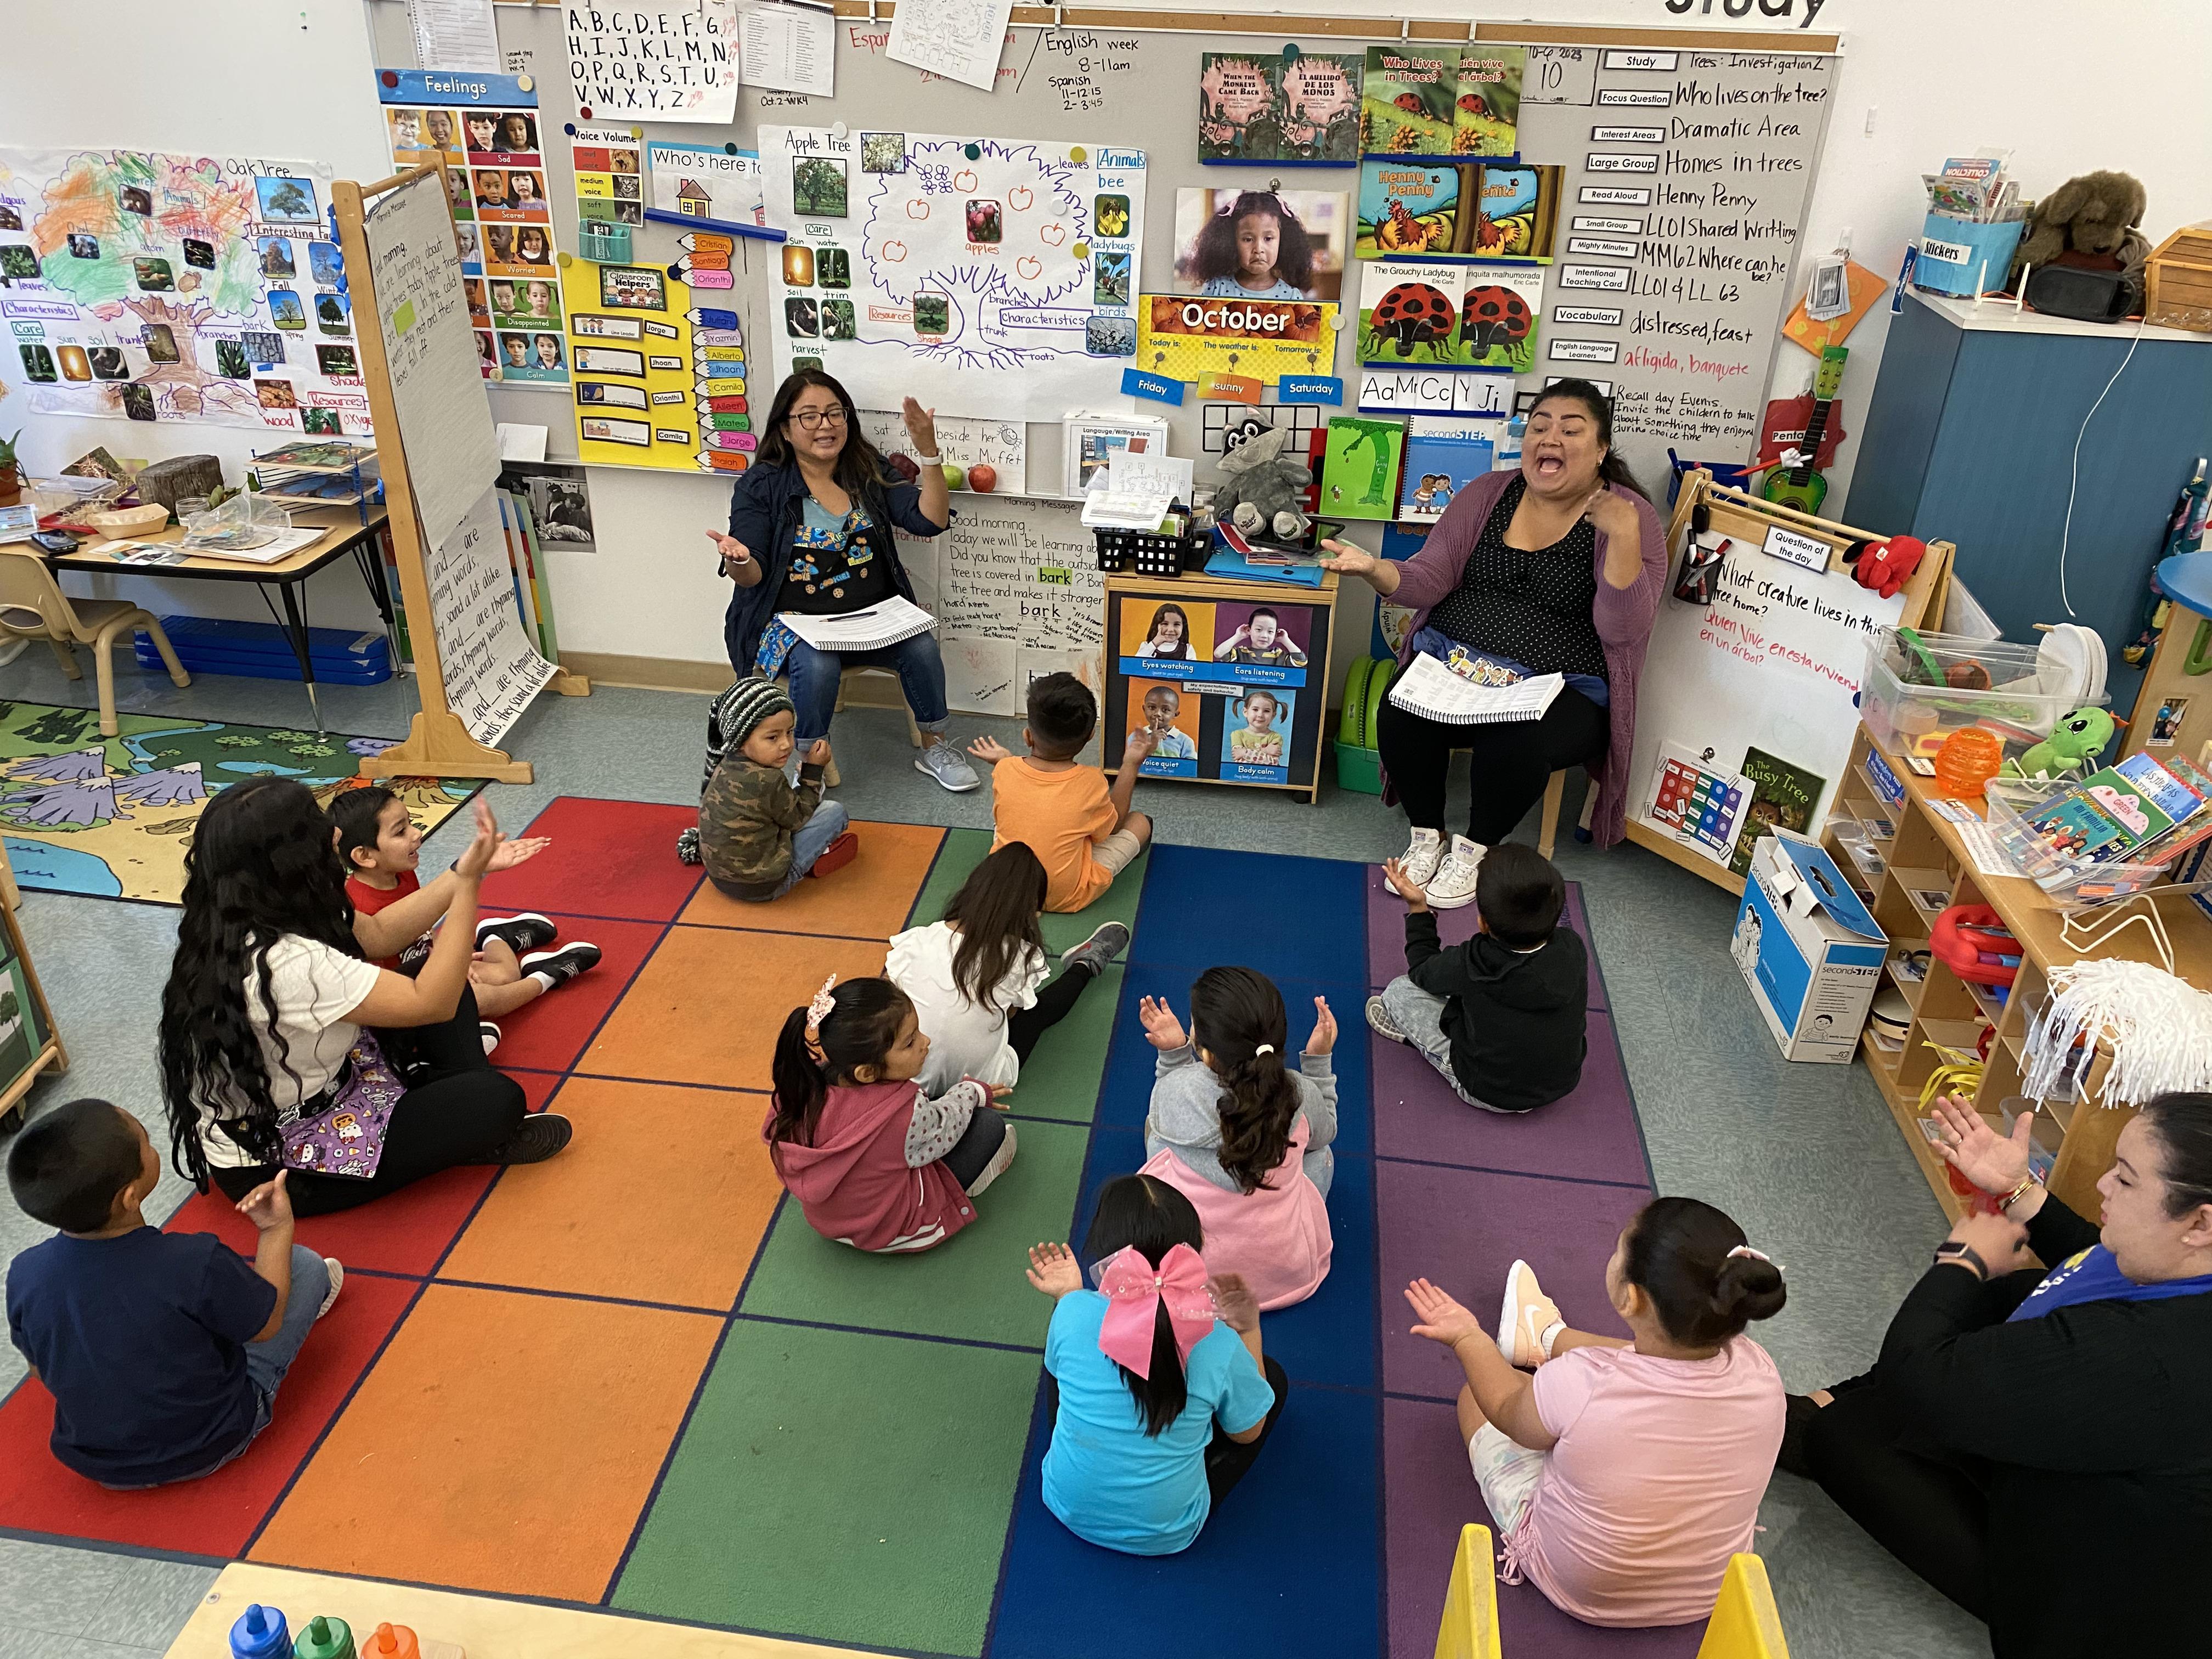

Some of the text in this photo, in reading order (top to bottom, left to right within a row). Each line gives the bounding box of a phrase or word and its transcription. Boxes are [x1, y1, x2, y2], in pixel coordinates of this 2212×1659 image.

[1046, 32, 1138, 56] English week
[1384, 56, 1443, 69] Who Lives
[1481, 59, 1504, 69] vive
[1627, 56, 1656, 68] Study
[1049, 76, 1090, 90] Spanish
[1385, 71, 1438, 83] in Trees?
[425, 75, 487, 100] Feelings
[1062, 87, 1101, 99] 11-12:15
[1602, 93, 1668, 105] Focus Question
[1672, 114, 1801, 141] Dramatic Area
[574, 131, 637, 143] Voice Volume
[1601, 130, 1656, 140] Interest Areas
[785, 130, 851, 155] Apple Tree
[498, 155, 511, 163] Sad
[653, 149, 746, 172] Who's here
[1058, 156, 1089, 170] leaves
[1590, 158, 1655, 172] Large Group
[1665, 150, 1803, 175] Homes in trees
[227, 159, 257, 176] Oak
[1945, 168, 1990, 177] COLLECTION
[1098, 176, 1124, 188] bee
[1379, 171, 1425, 184] Henny
[1389, 183, 1435, 198] Penny
[1592, 191, 1638, 201] Read Aloud
[1657, 182, 1757, 215] Henny Penny
[501, 211, 525, 219] Scared
[256, 224, 314, 239] Interesting
[1586, 220, 1628, 230] Small Group
[425, 235, 443, 259] about
[966, 243, 1000, 256] apples
[1578, 242, 1598, 251] Mighty
[1925, 241, 1959, 260] Stickers
[506, 266, 535, 274] Worried
[1374, 266, 1455, 279] The Grouchy Ladybug
[1575, 268, 1616, 278] Intentional
[610, 273, 654, 282] Classroom
[1566, 278, 1622, 288] Teaching Card
[18, 279, 48, 291] leaves
[272, 281, 290, 291] Fall
[428, 272, 457, 301] the cold
[616, 279, 651, 290] Helpers
[823, 290, 849, 299] trim
[507, 318, 550, 327] Disappointed
[1182, 303, 1291, 331] October
[1560, 311, 1618, 323] Vocabulary
[15, 323, 41, 334] Care
[242, 319, 270, 331] bark
[647, 325, 666, 335] Jorge
[88, 330, 109, 346] soil
[115, 331, 144, 345] trunk
[200, 331, 238, 340] branches
[710, 335, 738, 343] Yazmin
[1149, 338, 1171, 347] Today
[1219, 342, 1248, 351] weather
[1274, 345, 1312, 353] Tomorrow
[1556, 343, 1613, 353] English Language
[712, 352, 741, 360] Alberto
[792, 343, 827, 356] harvest
[714, 365, 741, 374] Jhoan
[1689, 352, 1751, 382] banquete
[527, 371, 545, 379] Calm
[714, 383, 742, 391] Camila
[1138, 380, 1167, 396] Friday
[1215, 383, 1244, 394] sunny
[1290, 383, 1334, 396] Saturday
[313, 394, 363, 407] Resources
[1655, 392, 1674, 408] day
[157, 411, 186, 419] roots
[263, 413, 295, 428] wood
[1737, 410, 1754, 421] talk
[718, 419, 746, 427] Mateo
[659, 432, 683, 441] Camila
[936, 425, 969, 442] beside
[726, 436, 751, 447] Jorge
[947, 447, 1022, 465] Miss Muffet
[1004, 497, 1077, 514] Morning Message
[464, 527, 479, 549] are
[950, 527, 1083, 557] Today learning
[1775, 533, 1813, 552] Question
[950, 545, 1064, 567] Did know that the
[1779, 547, 1812, 566] the day
[433, 551, 449, 580] and
[951, 563, 1071, 585] tree covered bark
[951, 580, 1103, 607] the tree and makes stronger
[1757, 580, 1842, 621] creature lives
[1020, 600, 1062, 617] bark
[448, 607, 490, 656] and are
[1142, 660, 1194, 673] Eyes watching
[1235, 667, 1285, 679] Ears listening
[1238, 766, 1256, 775] Body
[1756, 759, 1770, 772] The
[2141, 768, 2154, 780] LAS
[1745, 763, 1780, 784] Busy
[1782, 772, 1811, 805] Tree
[2113, 799, 2132, 815] GREEN
[2073, 804, 2108, 833] MI FAMILIA
